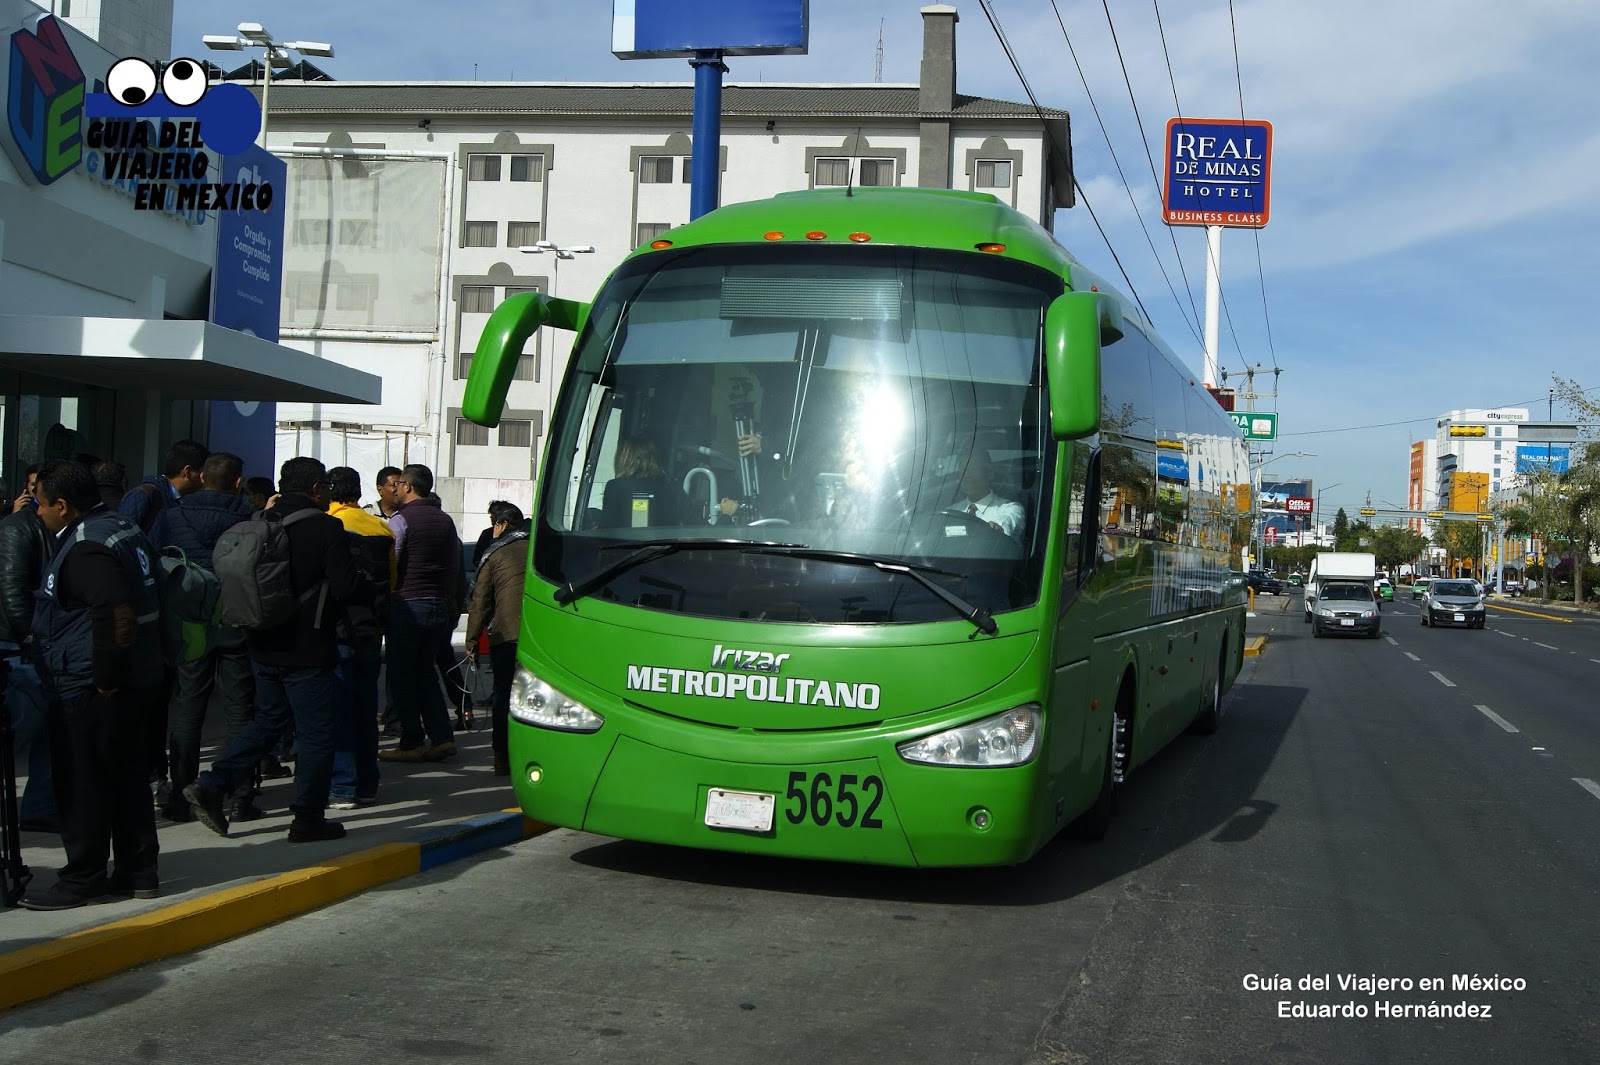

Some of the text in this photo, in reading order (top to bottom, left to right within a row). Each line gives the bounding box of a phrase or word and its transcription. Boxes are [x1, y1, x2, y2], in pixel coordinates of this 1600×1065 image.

[1176, 133, 1262, 160] REAL
[1175, 161, 1261, 177] DE MINAS
[1184, 185, 1252, 198] HOTEL
[1170, 211, 1262, 223] BUSINESS CLASS
[233, 236, 271, 264] Compromiso
[245, 226, 266, 246] Orgullo
[267, 239, 272, 251] y
[243, 260, 270, 281] Cumplido
[625, 664, 881, 711] METROPOLITANO
[785, 771, 884, 830] 5652
